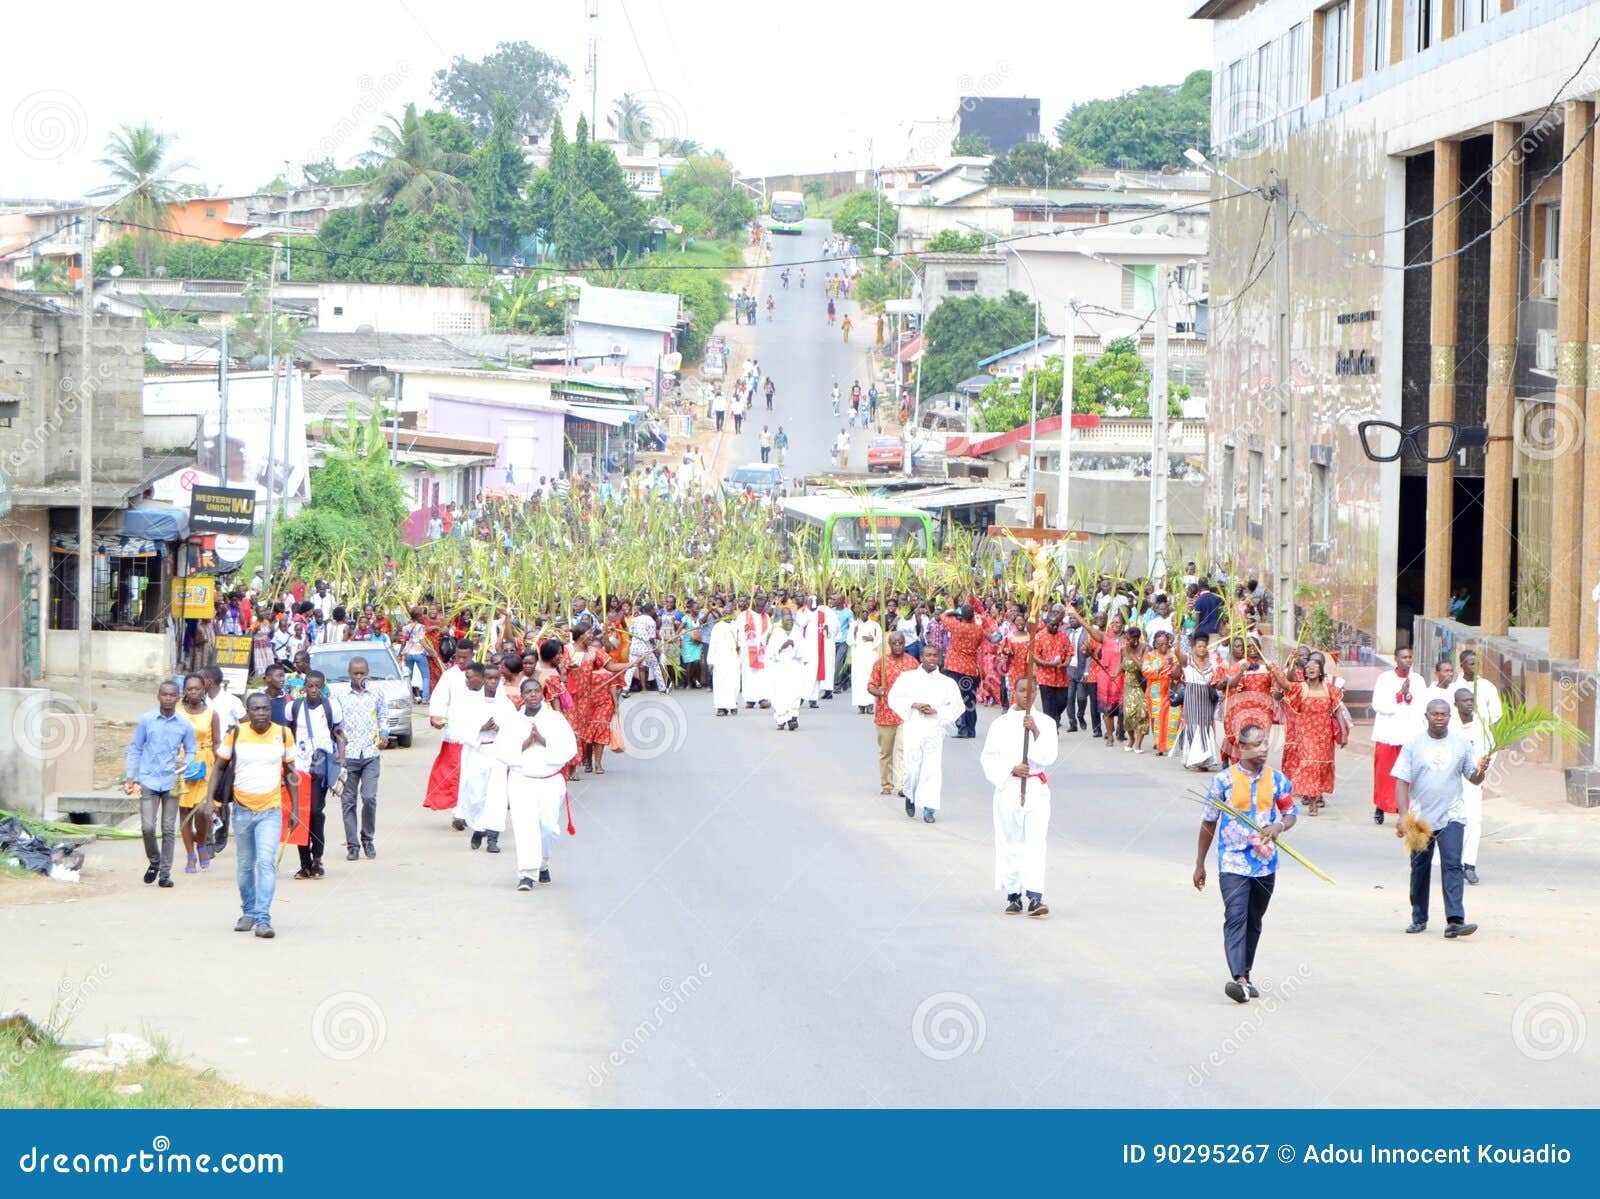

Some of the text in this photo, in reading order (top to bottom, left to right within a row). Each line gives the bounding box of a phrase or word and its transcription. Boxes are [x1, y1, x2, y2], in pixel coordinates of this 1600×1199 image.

[1456, 447, 1467, 466] 1
[195, 494, 232, 504] WESTERN
[206, 503, 231, 512] UNION
